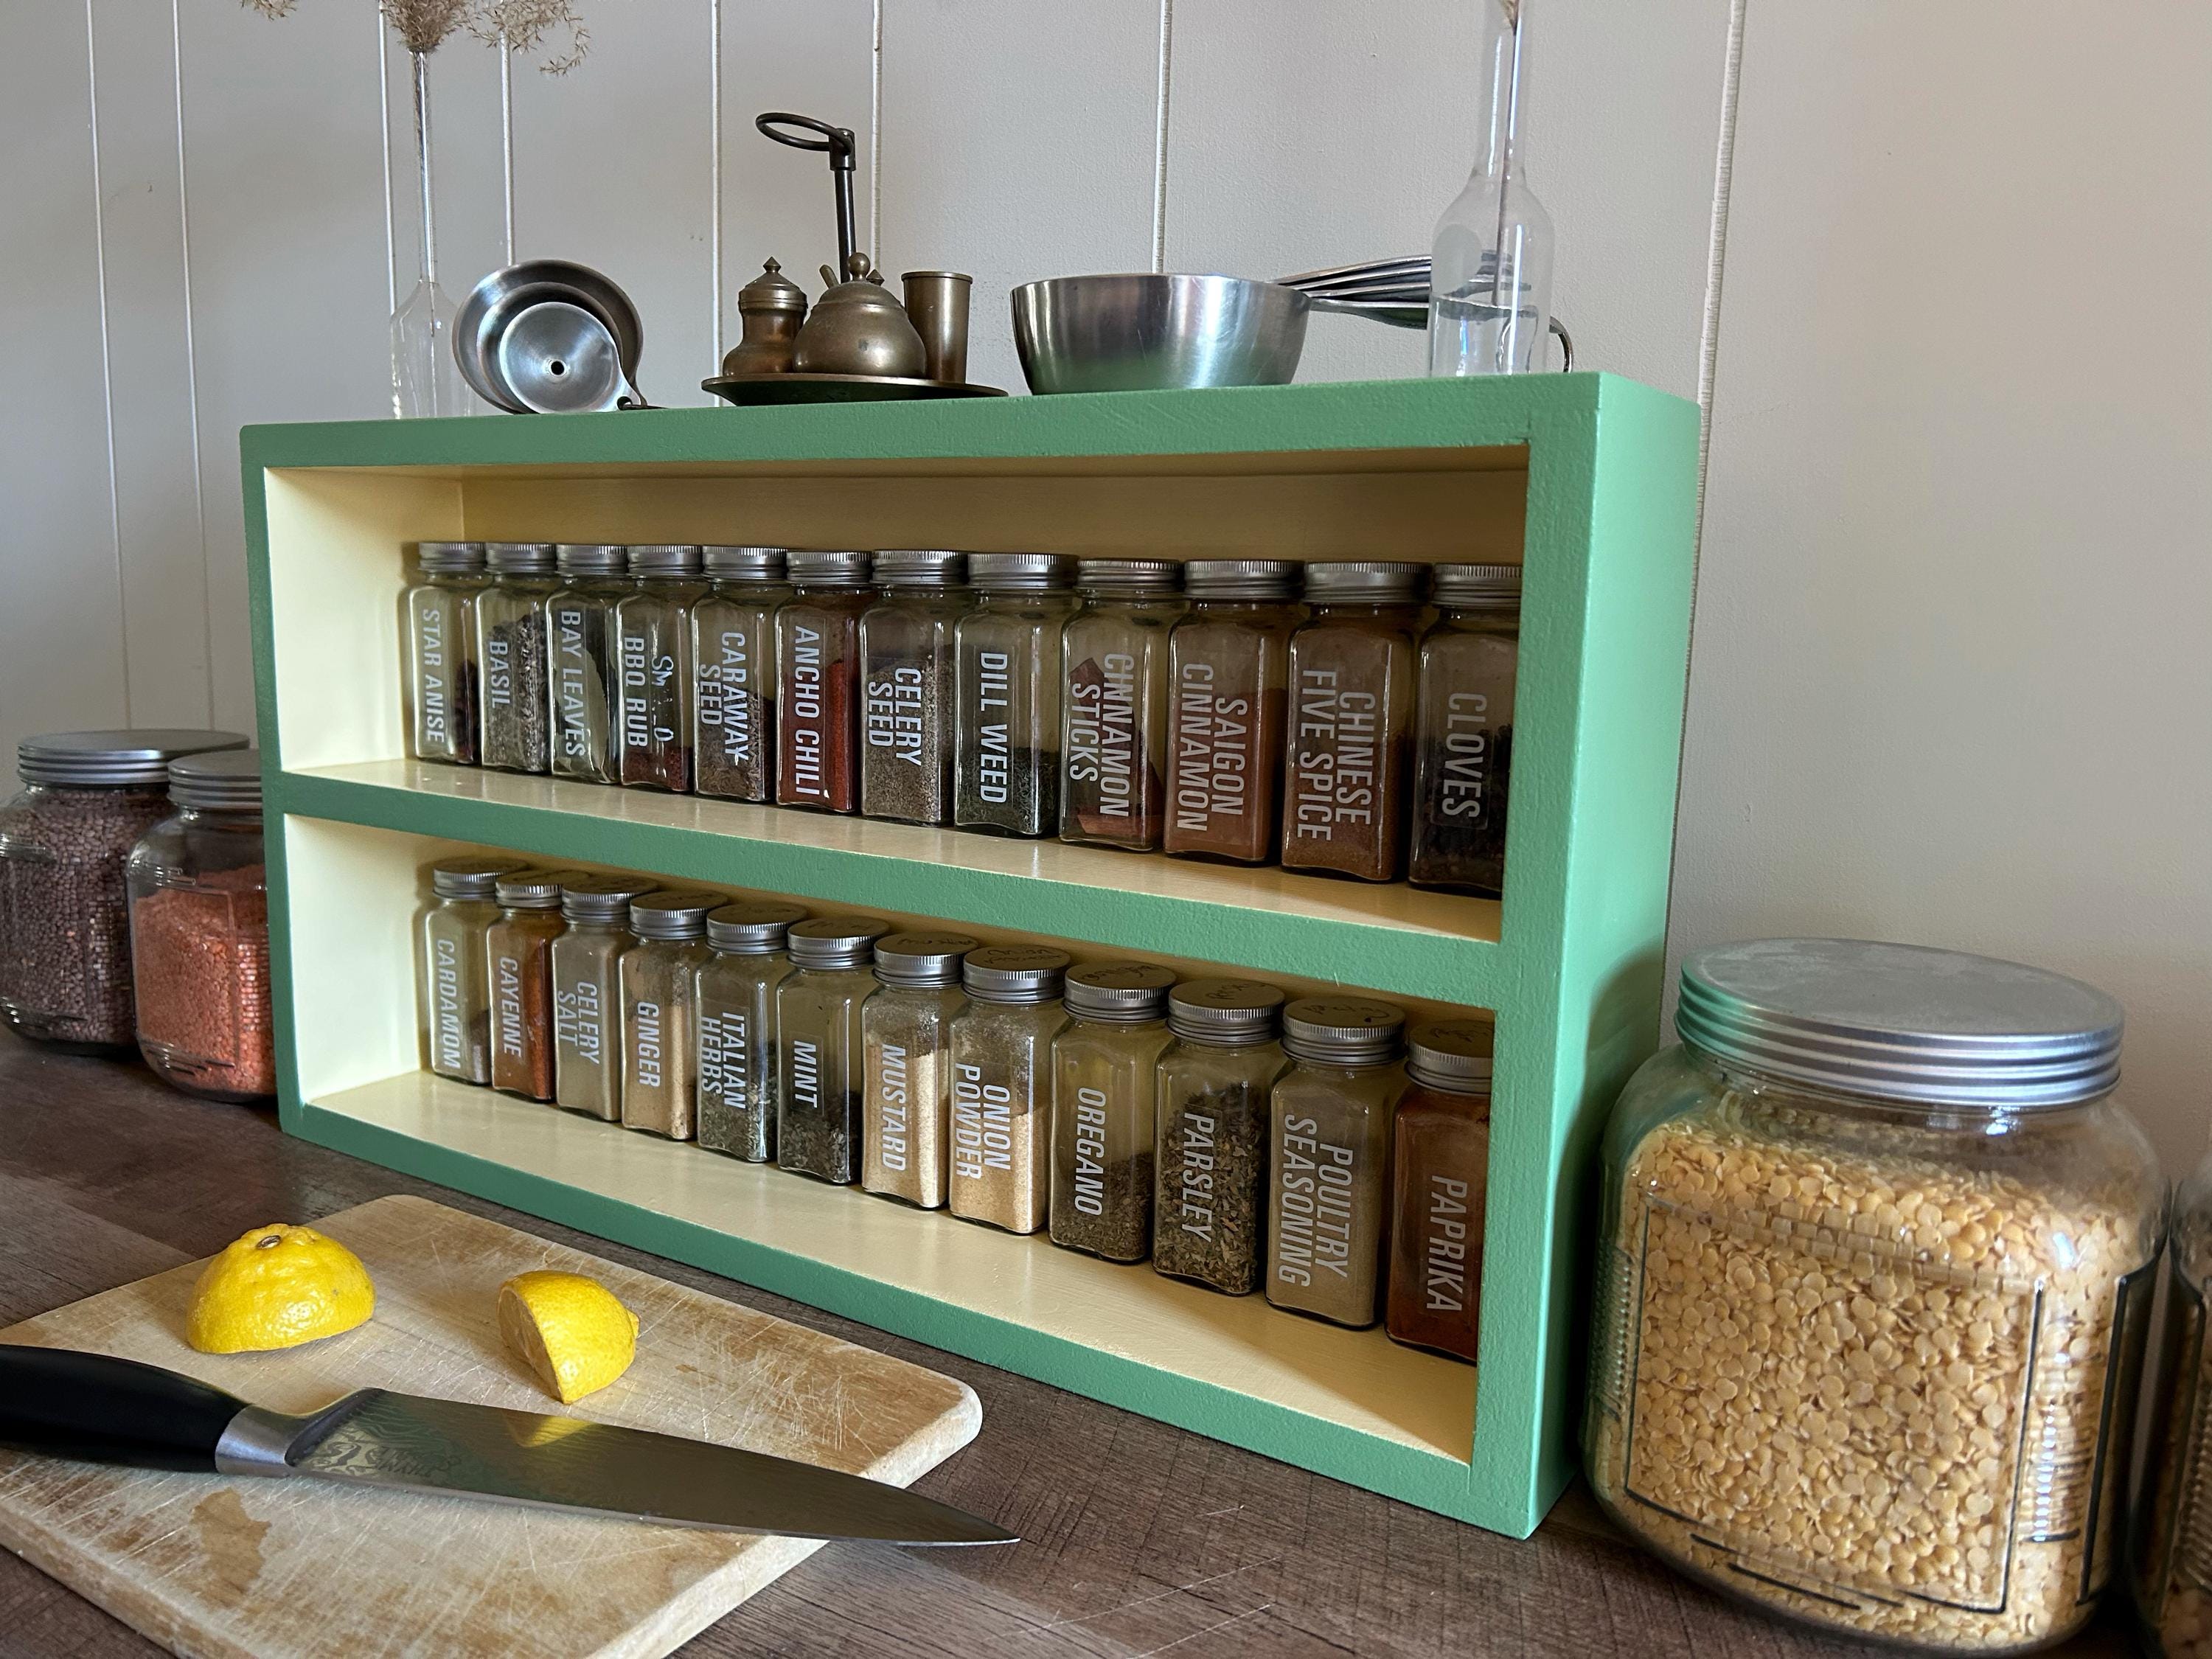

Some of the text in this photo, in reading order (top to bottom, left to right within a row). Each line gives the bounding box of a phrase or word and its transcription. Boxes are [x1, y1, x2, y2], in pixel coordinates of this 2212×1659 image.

[422, 609, 444, 743] STAR ANISE
[489, 641, 510, 709] BASIL
[561, 611, 585, 757] BAY LEAVES
[625, 637, 648, 747] BBQ RUB
[700, 664, 723, 726] SEED
[721, 632, 748, 761] CARAWAY
[795, 625, 820, 796] ANCHO CHILI
[869, 681, 893, 747] SEED
[894, 667, 922, 766] CELERY
[980, 652, 1007, 803] DILL WEED
[1069, 683, 1100, 782] STICKS
[1099, 653, 1135, 817] CINNAMON
[1177, 663, 1214, 832] CINNAMON
[1211, 698, 1248, 815] SAIGON
[1298, 669, 1336, 841] FIVE SPICE
[1335, 692, 1375, 825] CHINESE
[1441, 692, 1486, 818] CLOVES
[437, 939, 461, 1069] CARDAMOM
[500, 956, 522, 1057] CAYENNE
[557, 990, 579, 1047] SALT
[577, 981, 599, 1064] CELERY
[637, 1001, 661, 1088] GINGER
[701, 1016, 722, 1093] HERBS
[723, 1012, 745, 1109] ITALIAN
[793, 1040, 818, 1107] MINT
[882, 1043, 906, 1171] MUSTARD
[955, 1062, 982, 1180] POWDER
[983, 1084, 1011, 1171] ONION
[1074, 1087, 1107, 1216] OREGANO
[1182, 1112, 1215, 1244] PARSLEY
[1279, 1113, 1317, 1287] SEASONING
[1316, 1142, 1354, 1279] POULTRY
[1426, 1175, 1468, 1311] PAPRIKA
